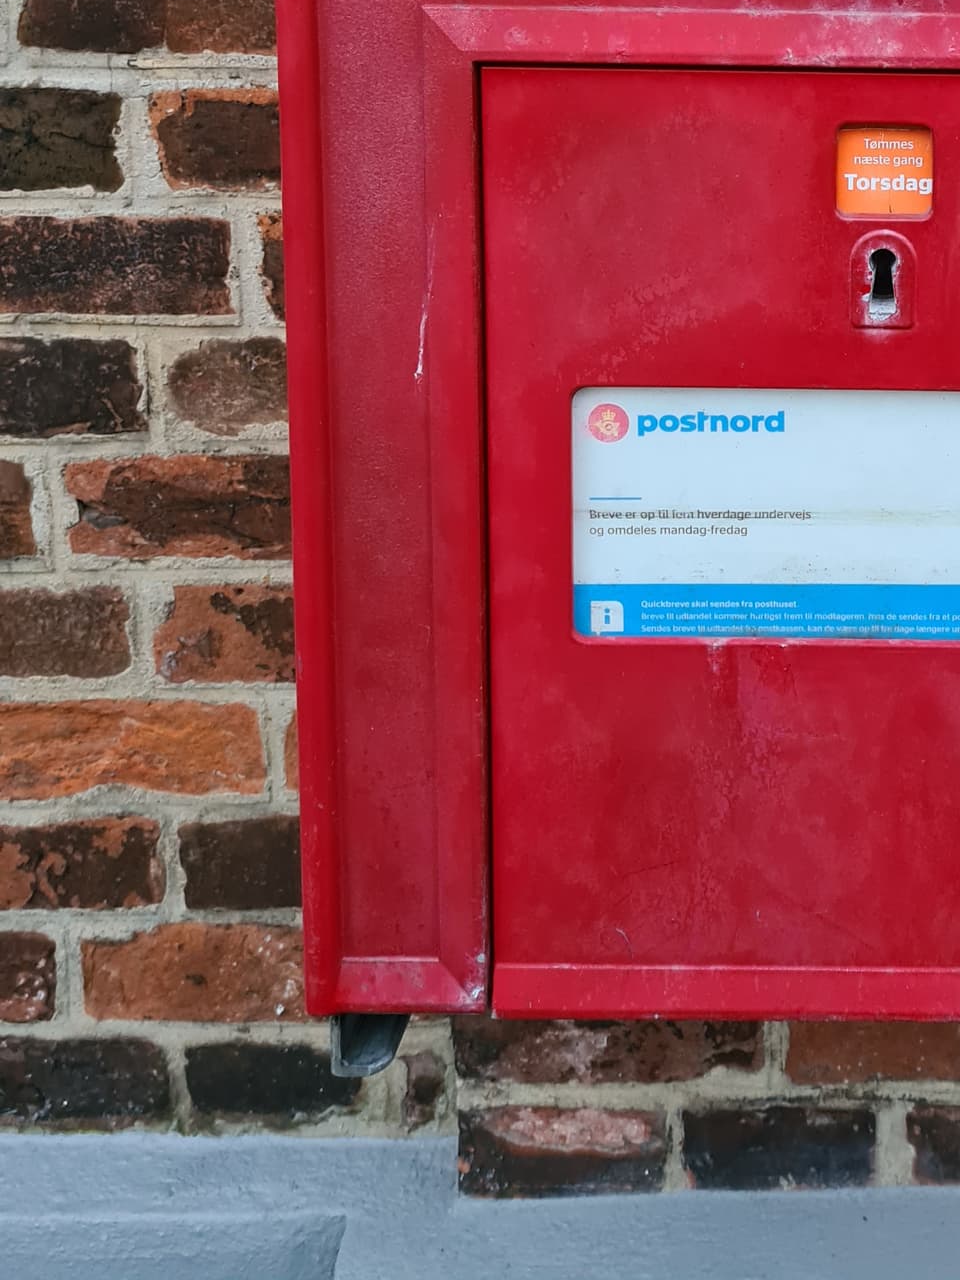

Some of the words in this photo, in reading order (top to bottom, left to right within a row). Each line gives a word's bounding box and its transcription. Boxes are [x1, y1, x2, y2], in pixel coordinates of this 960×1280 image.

[864, 138, 914, 150] Tømmes
[853, 155, 891, 166] næste
[893, 155, 924, 167] gang
[844, 173, 933, 195] Torsdag
[637, 410, 785, 437] postnord
[589, 509, 622, 520] Breve
[625, 511, 637, 520] er
[640, 511, 655, 521] op
[658, 508, 669, 520] til
[696, 509, 751, 522] hverdage
[754, 509, 812, 522] undervejs
[589, 526, 604, 537] og
[607, 524, 657, 536] omdeles
[660, 524, 748, 538] mandag-fredag
[641, 600, 690, 608] Quickbreve
[691, 600, 709, 608] skal
[709, 600, 740, 608] sendes
[741, 600, 753, 608] fra
